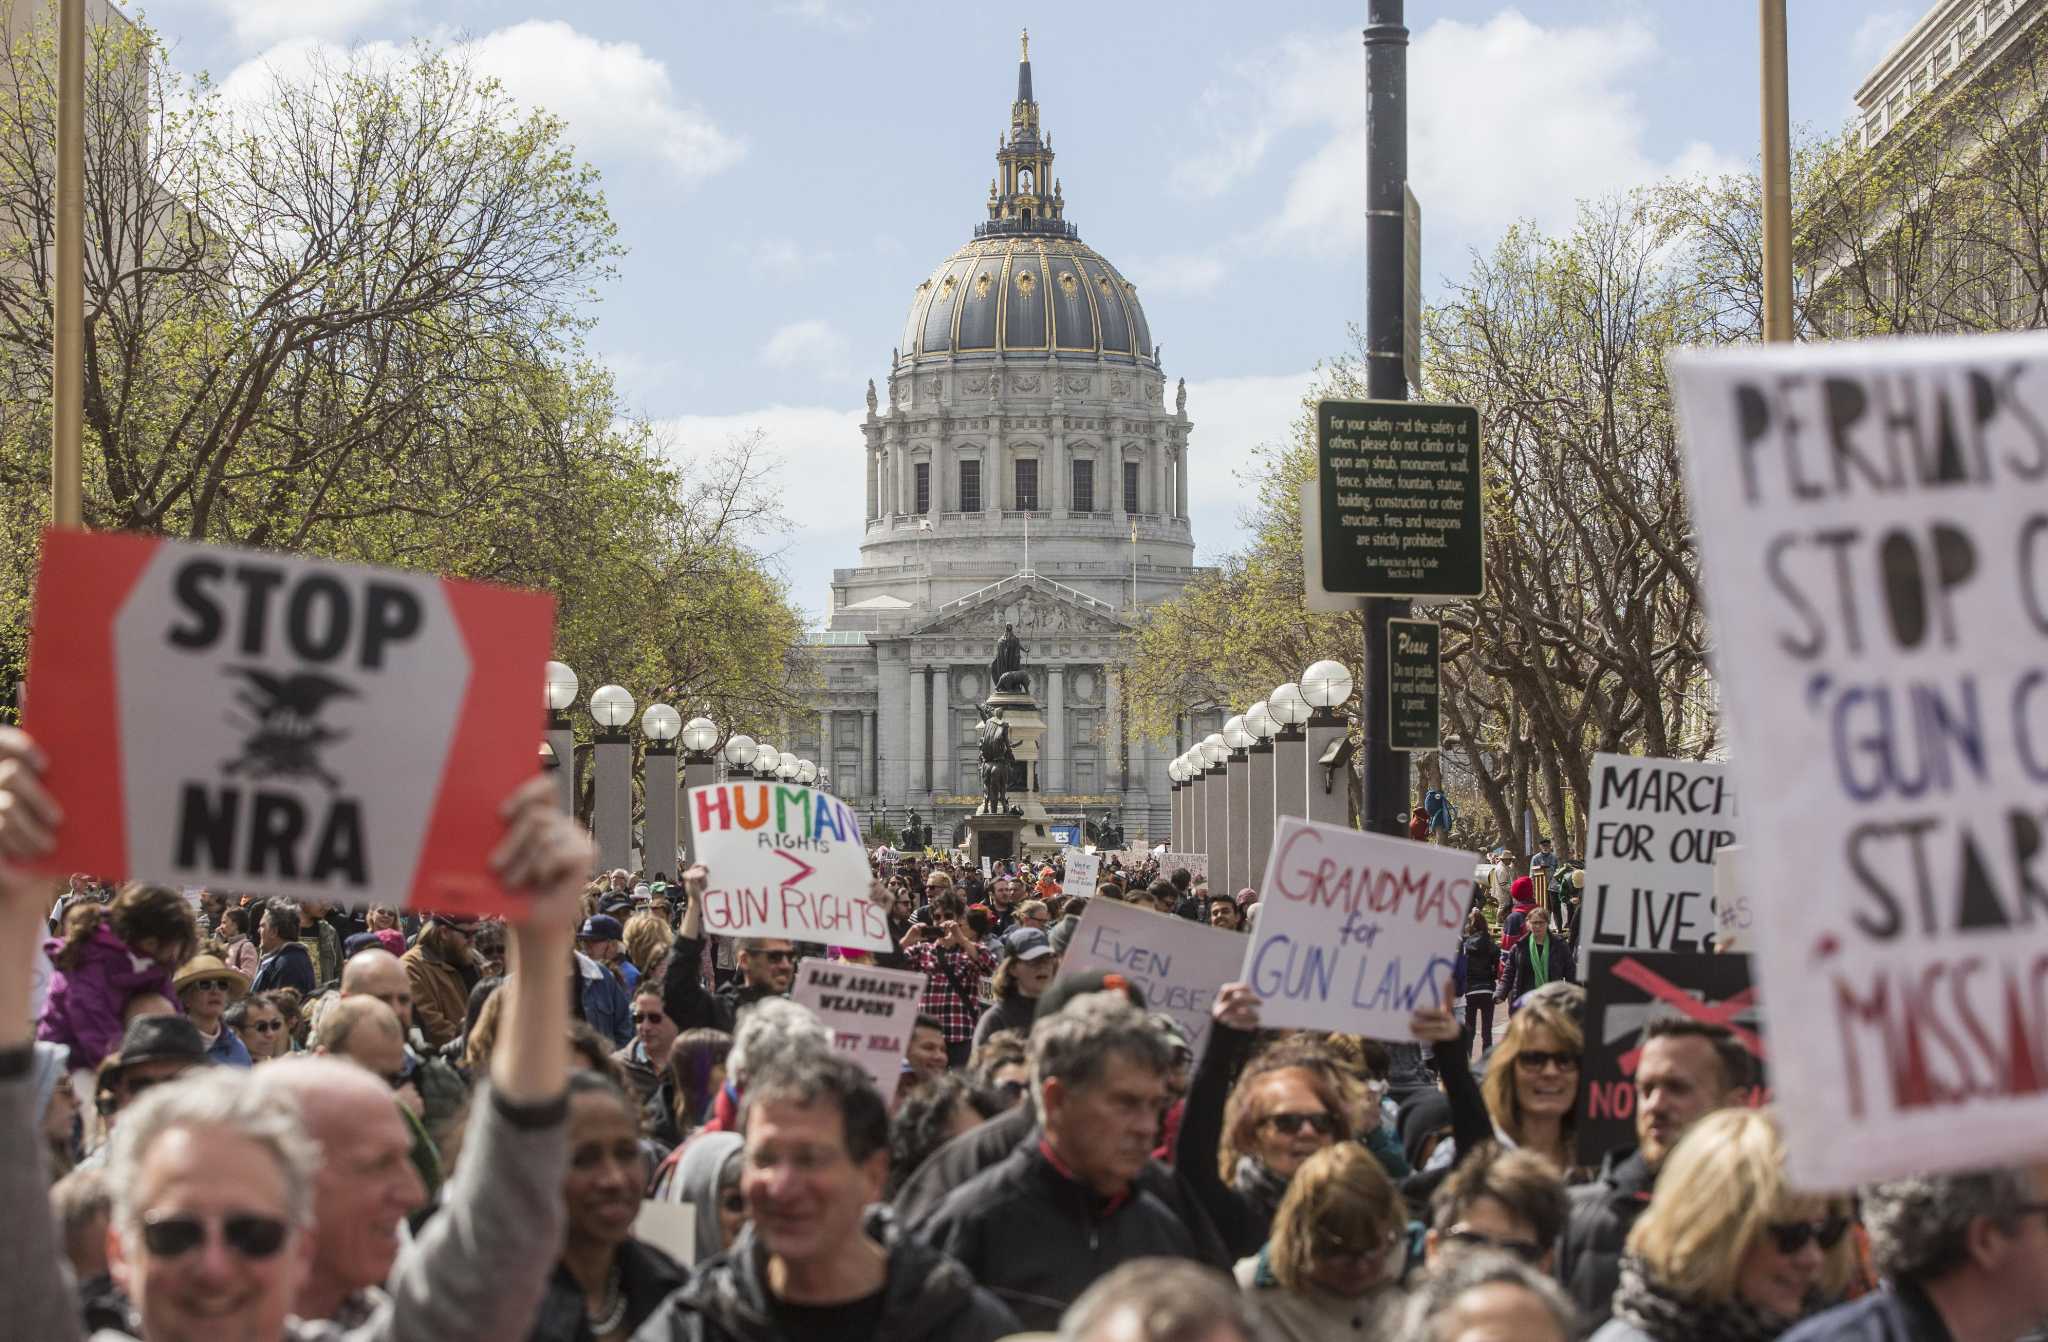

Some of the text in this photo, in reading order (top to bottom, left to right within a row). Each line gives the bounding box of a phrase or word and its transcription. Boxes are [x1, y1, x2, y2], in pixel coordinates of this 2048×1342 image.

[1331, 416, 1344, 430] For
[1347, 419, 1365, 433] your
[1368, 418, 1392, 436] safety
[1414, 419, 1428, 433] the
[1431, 420, 1455, 438] safety
[1457, 421, 1467, 435] of
[1361, 436, 1388, 453] please
[1390, 437, 1402, 450] do
[1404, 439, 1418, 451] not
[1421, 438, 1444, 453] climb
[1446, 443, 1455, 453] or
[1457, 440, 1470, 457] lay
[1733, 360, 2048, 504] PERHAPS
[1330, 456, 1353, 472] upon
[1355, 459, 1369, 472] any
[1375, 496, 1427, 510] construction
[1429, 499, 1438, 510] or
[1441, 496, 1464, 511] other
[1384, 513, 1403, 528] Fires
[1405, 514, 1422, 529] and
[1424, 517, 1461, 533] weapons
[1356, 535, 1370, 546] are
[1373, 533, 1400, 549] strictly
[1766, 518, 1978, 662] STOP
[168, 558, 424, 674] STOP
[1599, 765, 1738, 816] MARCH
[173, 780, 370, 890] NRA
[695, 784, 863, 847] HUMAN
[758, 832, 830, 855] RIGHTS
[1594, 821, 1655, 862] FOR
[1275, 827, 1472, 929] GRANDMAS
[704, 886, 886, 940] GUN RIGHTS
[1340, 909, 1381, 947] for
[1091, 925, 1172, 978] EVEN
[1252, 933, 1337, 1001] GUN
[808, 970, 920, 1000] BAN ASSAULT
[819, 993, 895, 1018] WEAPONS
